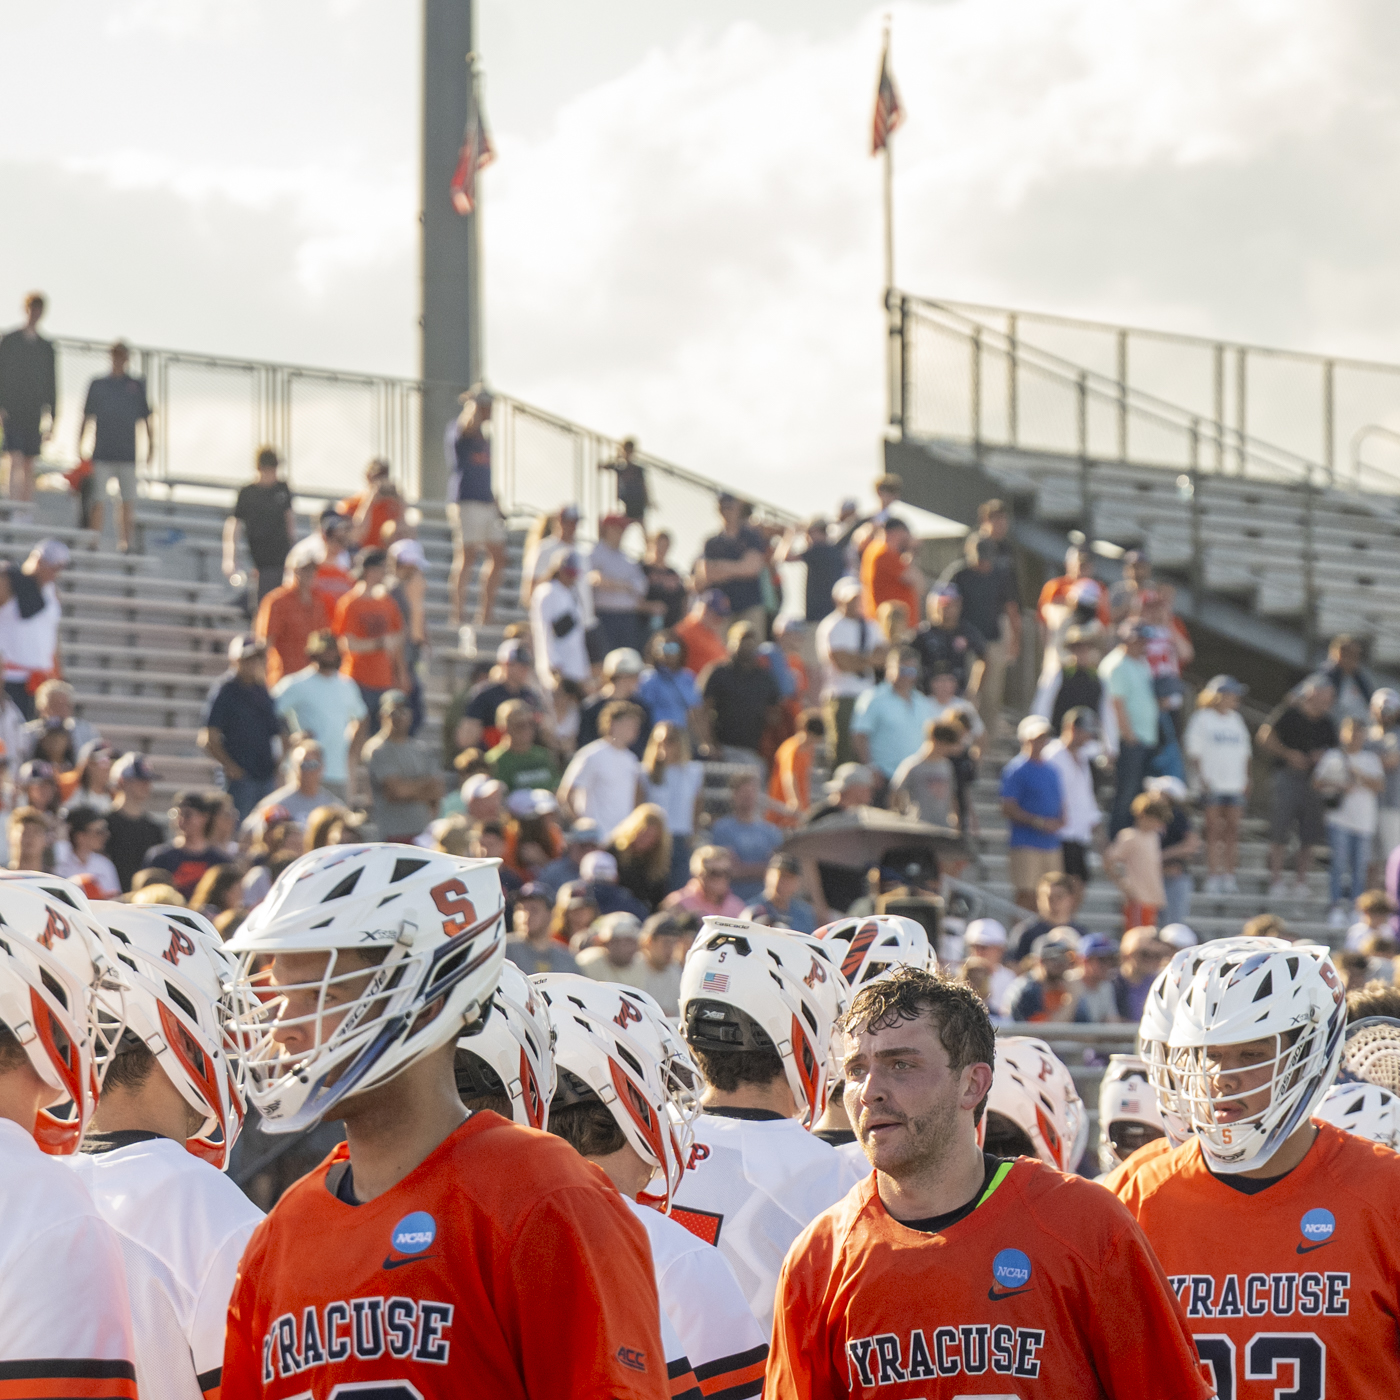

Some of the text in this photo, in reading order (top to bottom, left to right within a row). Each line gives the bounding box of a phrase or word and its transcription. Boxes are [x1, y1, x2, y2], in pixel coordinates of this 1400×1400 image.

[429, 877, 478, 938] S
[37, 904, 71, 951] P
[714, 920, 750, 930] cascade
[162, 925, 196, 966] P
[803, 956, 827, 990] P
[613, 996, 643, 1030] P
[1038, 1057, 1053, 1082] P
[1221, 1128, 1233, 1145] S
[685, 1142, 713, 1172] P
[395, 1231, 435, 1245] NCAA
[1304, 1223, 1334, 1234] NCAA
[996, 1266, 1029, 1280] NCAA
[616, 1345, 647, 1371] ACC
[845, 1323, 1046, 1392] YRACUSE
